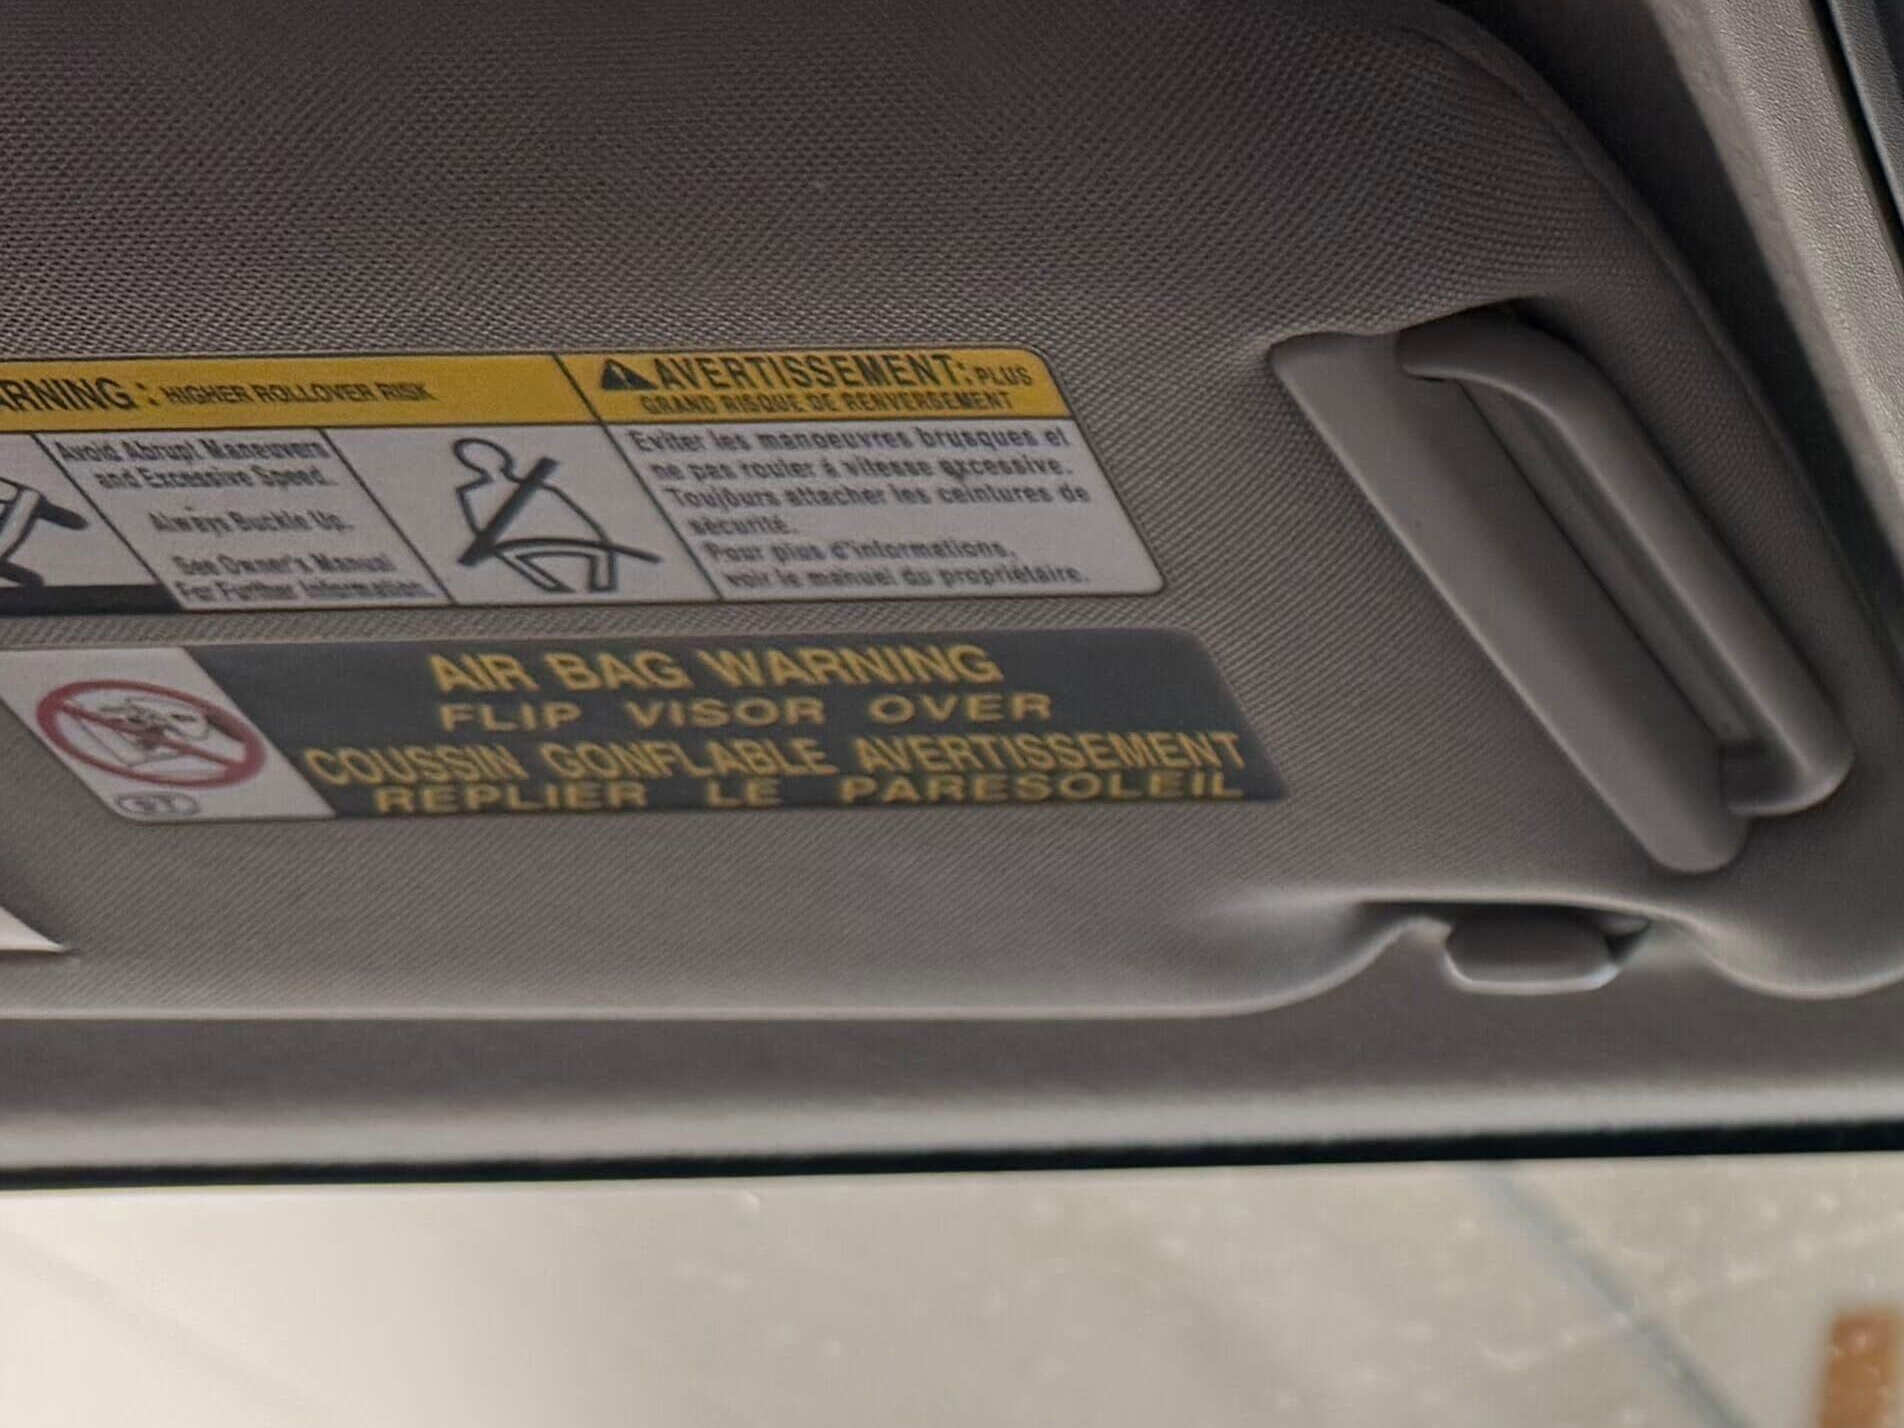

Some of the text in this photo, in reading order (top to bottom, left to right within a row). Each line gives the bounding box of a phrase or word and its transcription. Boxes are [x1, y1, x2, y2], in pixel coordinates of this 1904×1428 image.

[654, 352, 1033, 390] AVERTISSEMENT: PLUS
[159, 383, 253, 405] HIGHER
[251, 382, 378, 404] ROLLOVER
[374, 381, 440, 403] RISK
[640, 390, 1014, 415] GRAND RISQUE DE RENVERSEMENT
[55, 441, 124, 463] Avoid
[121, 440, 201, 466] Abrupt
[706, 429, 752, 452] les
[756, 430, 914, 452] manoeuvres
[914, 426, 1040, 452] brusques
[1042, 426, 1072, 448] et
[95, 467, 143, 489] and
[136, 466, 255, 489] Excessive
[650, 462, 687, 481] ne
[687, 461, 738, 484] pas
[739, 458, 815, 480] rouler
[841, 454, 935, 478] vitesse
[662, 481, 1091, 513] Toujours attacher les ceintures de
[148, 511, 234, 537] Always
[227, 509, 313, 533] Buckle
[171, 555, 221, 577] See
[704, 540, 763, 564] Pour
[772, 540, 825, 566] plus
[426, 643, 1003, 694] AIR BAG WARNING
[439, 690, 1054, 734] FLIP VISOR OVER
[302, 730, 1247, 788] COUSSIN GONFLABLE AVERTISSEMENT
[373, 769, 1246, 816] REPLIER LE PARESOLEIL
